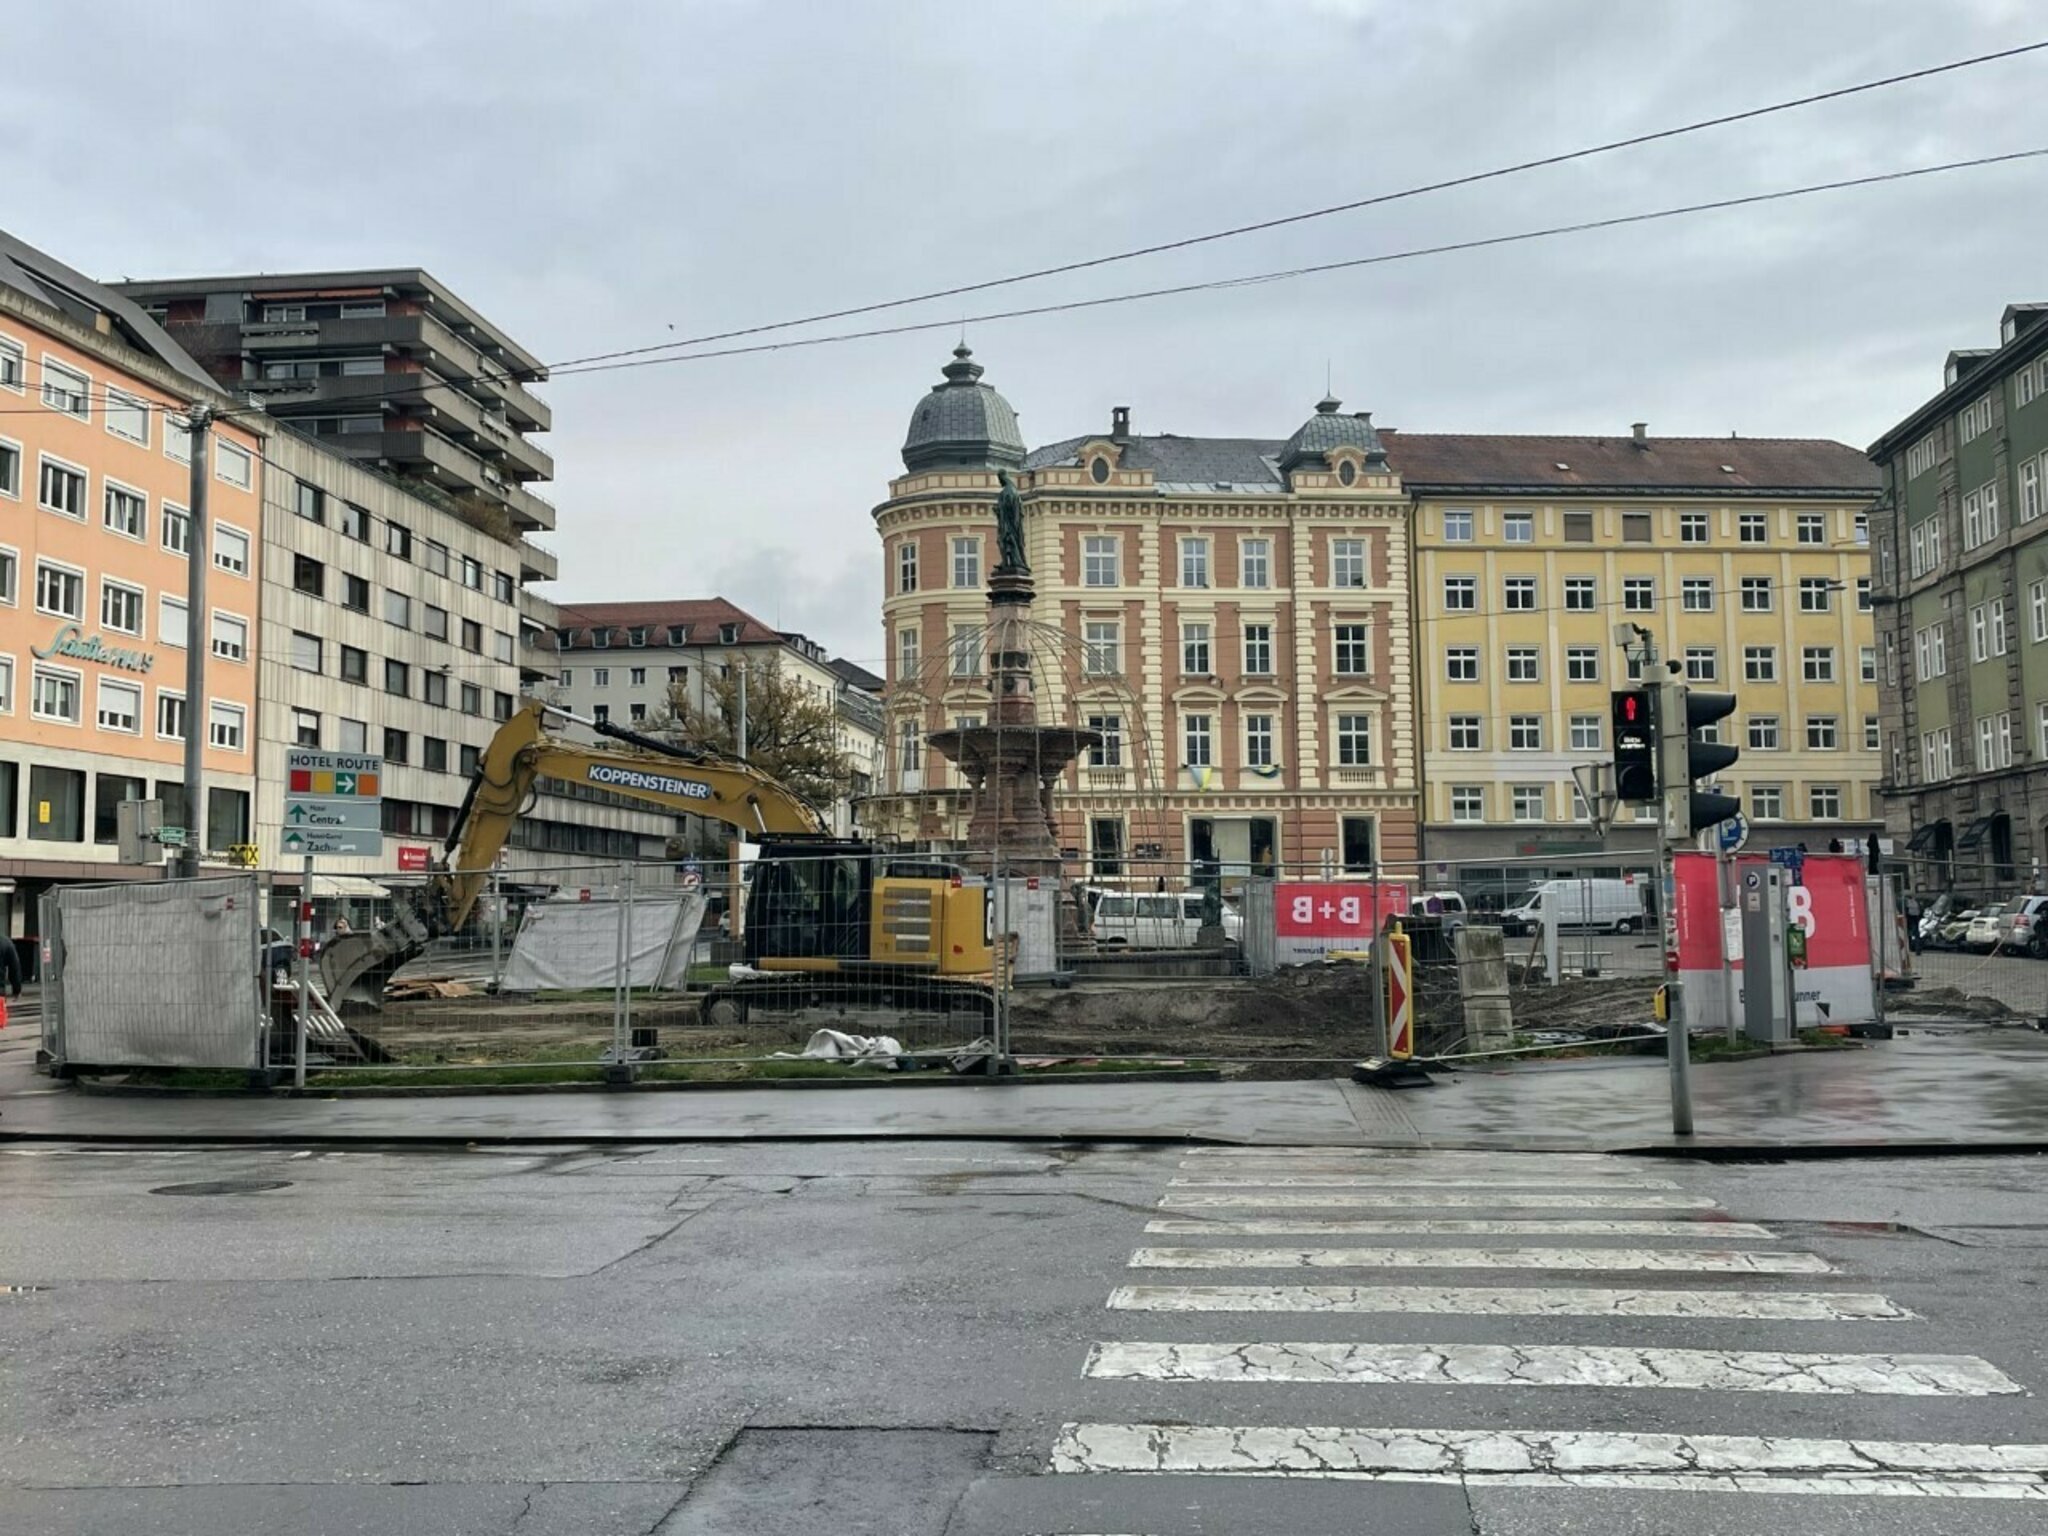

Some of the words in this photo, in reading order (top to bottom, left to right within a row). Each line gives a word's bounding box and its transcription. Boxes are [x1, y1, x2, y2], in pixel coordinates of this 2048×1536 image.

[290, 754, 332, 768] HOTEL
[336, 758, 379, 771] ROUTE
[588, 765, 707, 799] KOPPENSTEINER
